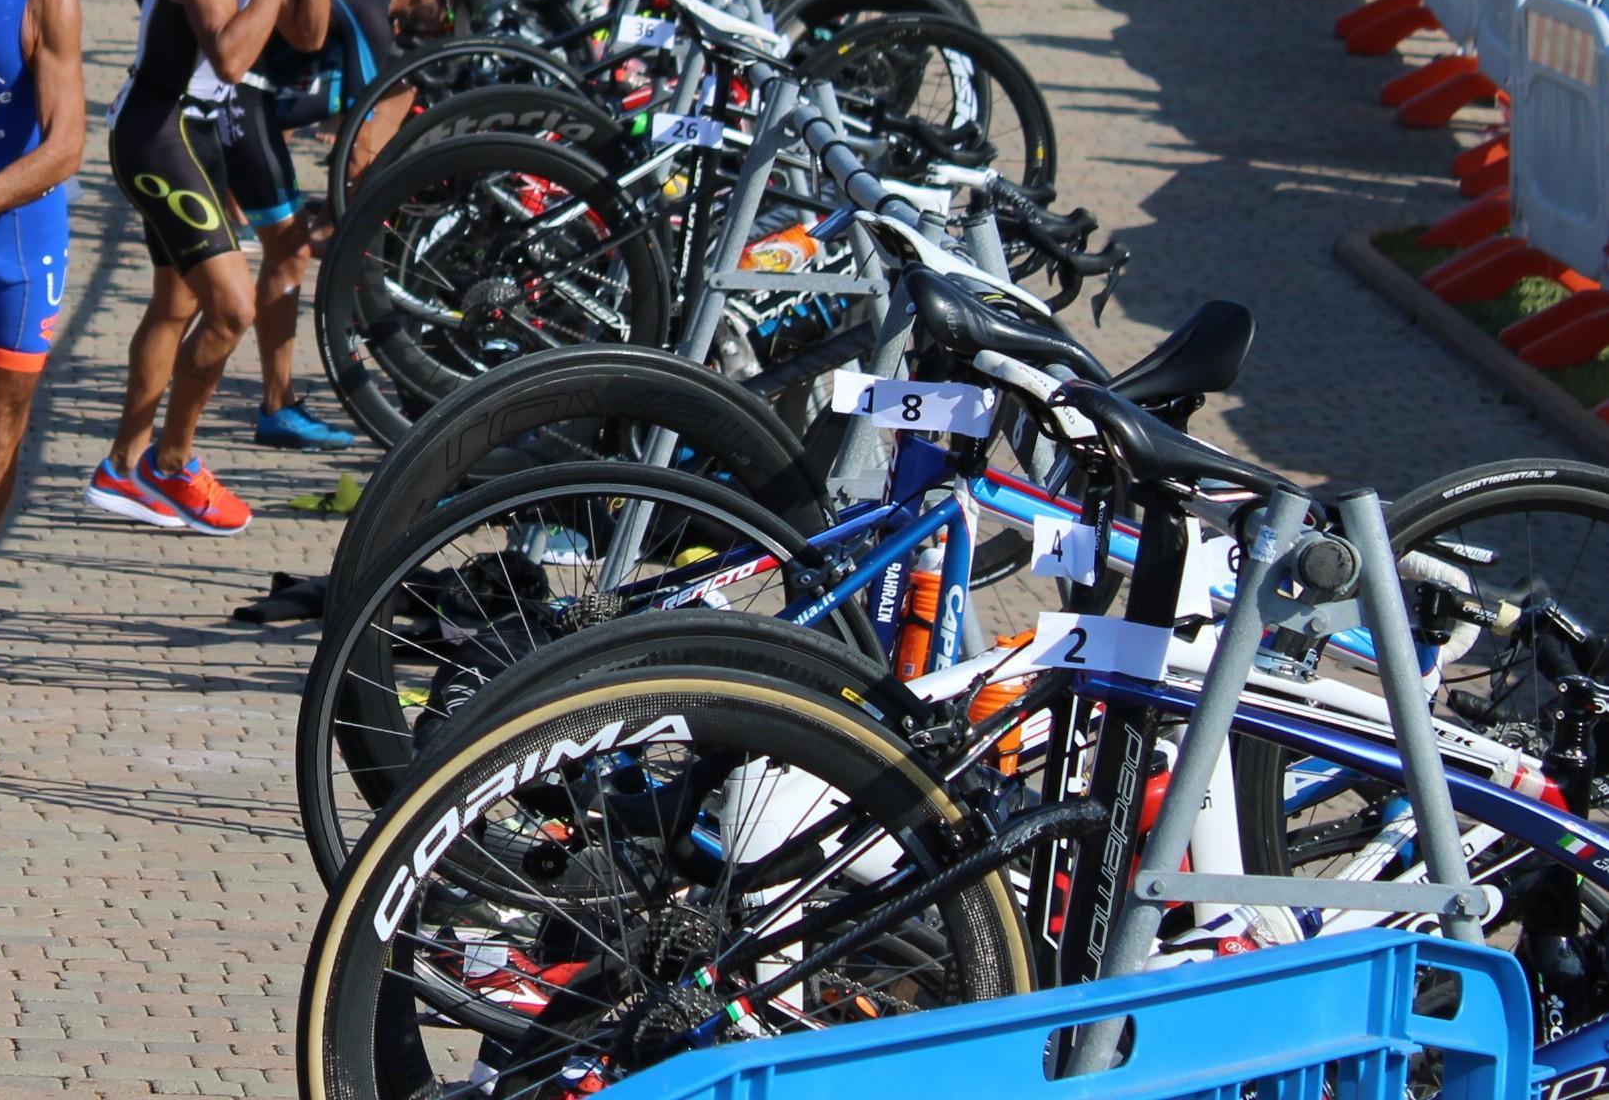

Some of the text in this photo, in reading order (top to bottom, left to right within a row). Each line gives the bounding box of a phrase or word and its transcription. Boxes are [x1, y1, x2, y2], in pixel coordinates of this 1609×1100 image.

[635, 20, 655, 38] 36
[672, 120, 698, 140] 26
[901, 393, 924, 422] 8
[1454, 467, 1543, 496] CONTINENTAL
[1051, 528, 1064, 564] 4
[661, 559, 759, 611] REACTO
[1063, 627, 1088, 664] 2
[373, 714, 694, 943] CORIMA
